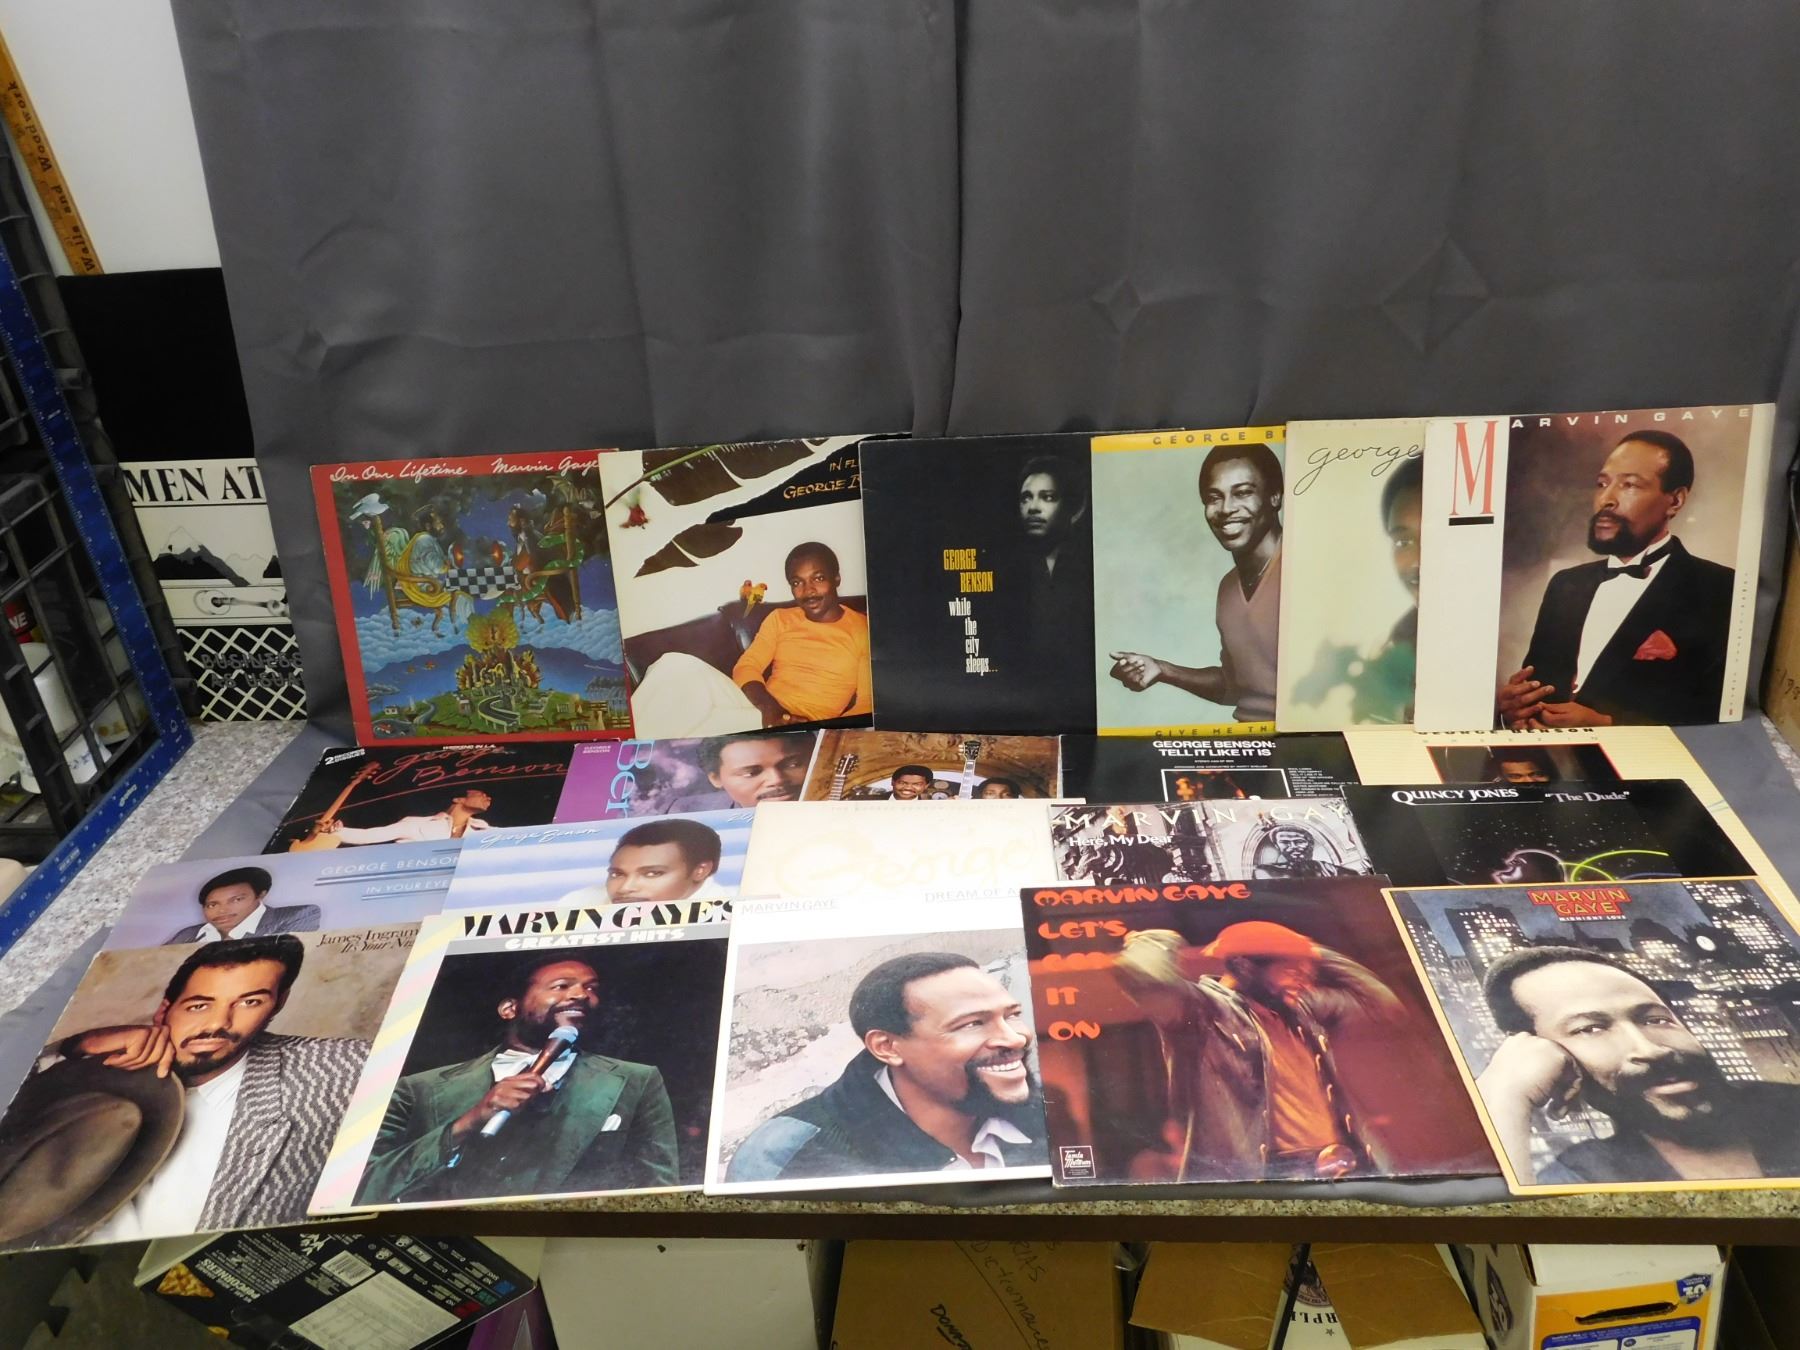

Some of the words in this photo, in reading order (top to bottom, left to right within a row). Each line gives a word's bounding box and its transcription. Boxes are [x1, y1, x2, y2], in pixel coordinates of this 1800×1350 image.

[7, 81, 52, 171] Woodwork
[52, 184, 72, 214] and
[72, 226, 95, 272] Walls
[1653, 408, 1750, 422] GAYE
[1153, 432, 1246, 445] GEORGE
[330, 466, 358, 482] In
[362, 465, 394, 480] Our
[399, 461, 467, 484] Lifetime
[491, 457, 553, 474] Marvin
[559, 456, 600, 477] Gaye
[829, 457, 843, 472] IN
[1293, 442, 1422, 496] george
[122, 466, 209, 503] MEN
[221, 465, 266, 500] AT
[783, 480, 847, 499] GEORGE
[943, 549, 976, 570] GEORGE
[960, 571, 994, 593] BENSON
[948, 597, 971, 616] while
[965, 616, 977, 636] the
[965, 636, 980, 657] city
[1155, 728, 1198, 737] GIVE
[1159, 749, 1194, 757] TELL
[1195, 749, 1207, 757] IT
[1209, 749, 1241, 757] LIKE
[1242, 749, 1256, 757] IT
[1257, 749, 1272, 757] IS
[1214, 740, 1277, 748] BENSON:
[325, 757, 334, 765] 2
[1392, 789, 1464, 806] QUINCY
[1468, 788, 1520, 802] JONES
[1064, 806, 1237, 830] MARVIN
[1069, 836, 1108, 848] Here,
[1110, 834, 1135, 848] My
[1137, 832, 1174, 845] Dear
[321, 862, 389, 876] GEORGE
[366, 886, 381, 894] IN
[386, 882, 421, 892] YOUR
[925, 889, 978, 903] DREAM
[1034, 887, 1158, 907] MARVIN
[1162, 883, 1251, 902] GAYE
[1531, 890, 1626, 902] MARVIN
[741, 899, 800, 914] MARVIN
[801, 899, 838, 911] GAYE
[1557, 902, 1616, 914] GAYE
[464, 908, 602, 937] MARVIN
[1038, 920, 1127, 940] LET'S
[316, 933, 361, 948] James
[365, 928, 420, 943] Ingram
[505, 932, 625, 950] GREATEST
[630, 928, 685, 941] HITS
[1046, 986, 1080, 1005] IT
[1048, 1020, 1100, 1041] ON
